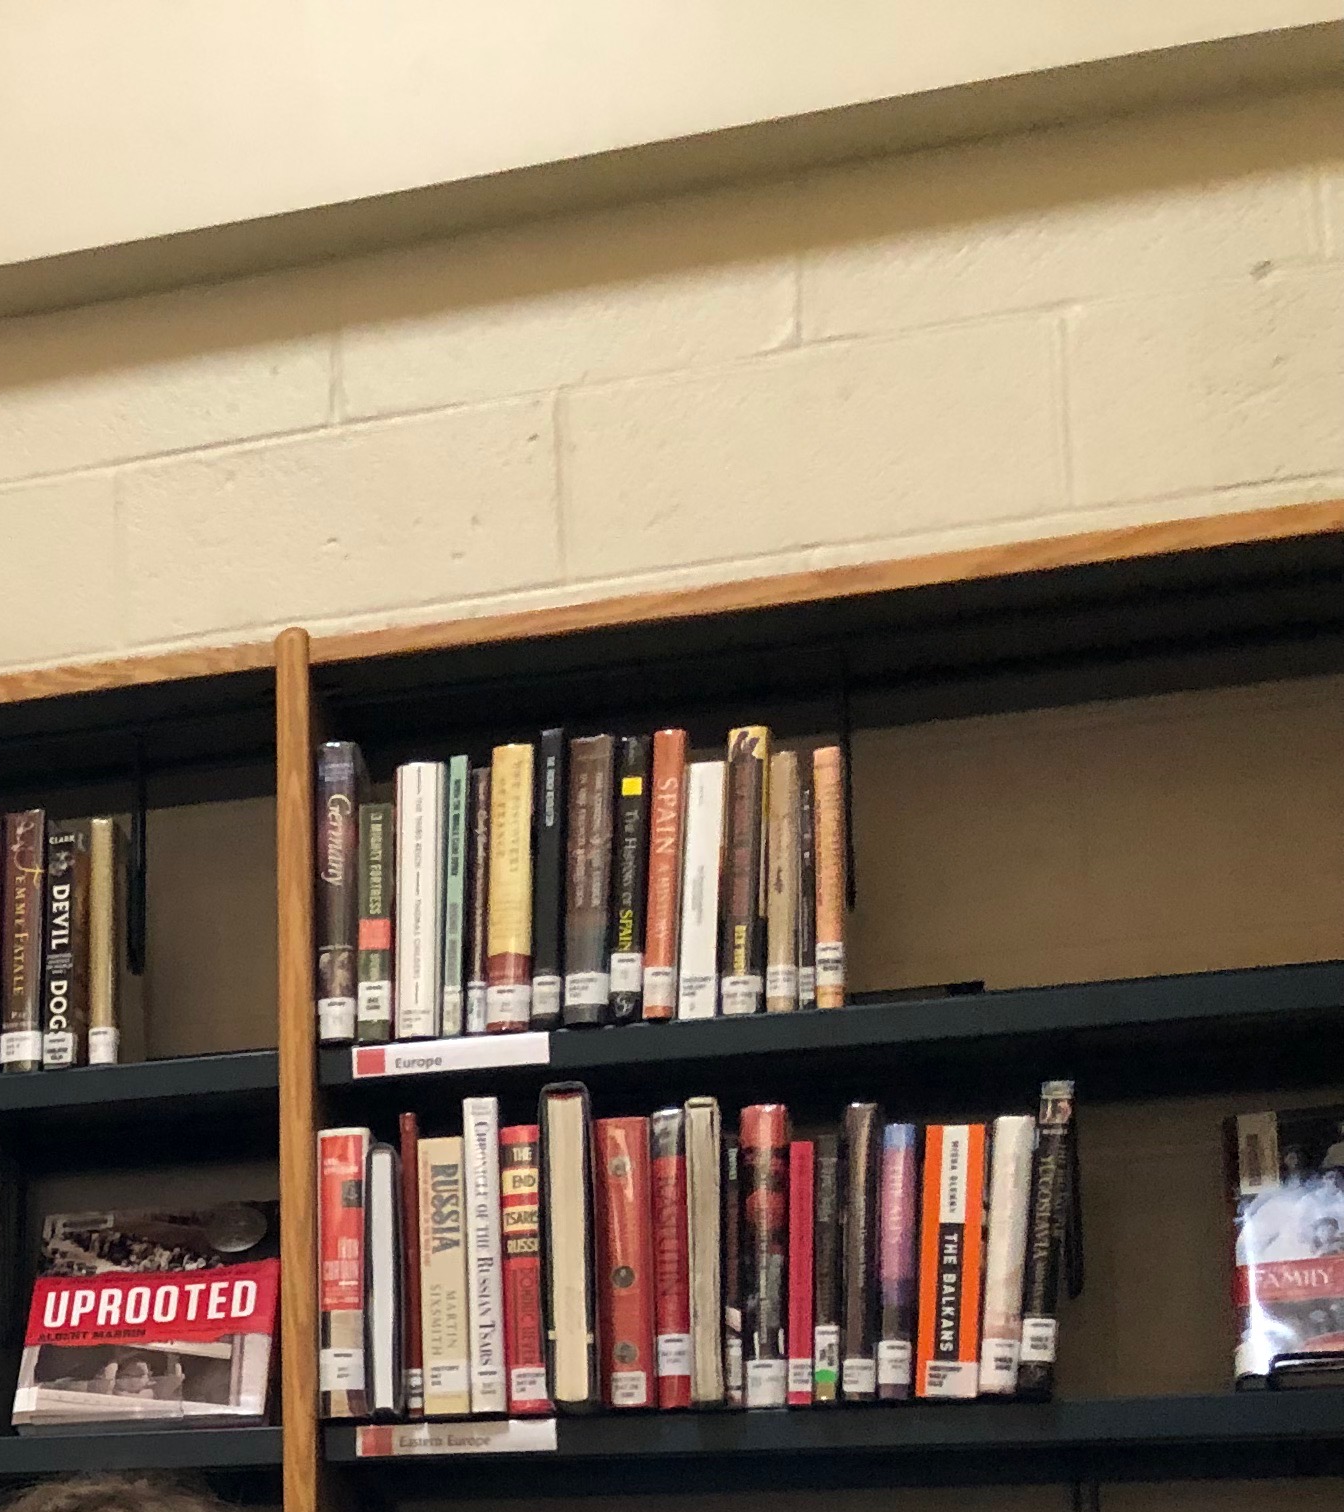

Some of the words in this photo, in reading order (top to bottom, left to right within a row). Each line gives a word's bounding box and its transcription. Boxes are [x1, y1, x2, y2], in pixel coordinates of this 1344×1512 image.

[320, 793, 352, 887] Germany
[654, 777, 678, 855] SPAIN
[50, 884, 70, 950] DEVIL
[368, 864, 382, 915] FORTRESS
[618, 909, 634, 951] SPAIN
[11, 931, 29, 996] FATALE
[395, 1055, 443, 1069] Europe
[473, 1121, 491, 1197] CHRONICLE
[512, 1147, 532, 1160] THE
[430, 1163, 461, 1254] RUSSIA
[942, 1234, 958, 1264] THE
[43, 1280, 257, 1328] UPROOTED
[476, 1257, 494, 1316] RUSSIAN
[939, 1273, 956, 1352] BALKANS
[38, 1329, 89, 1342] ALBERT
[92, 1328, 146, 1338] MARRIN
[430, 1283, 444, 1356] SIXSMITH
[445, 1290, 458, 1349] MARTIN
[478, 1320, 496, 1366] TSARS
[399, 1436, 444, 1449] Eastern
[447, 1435, 491, 1449] Europe
